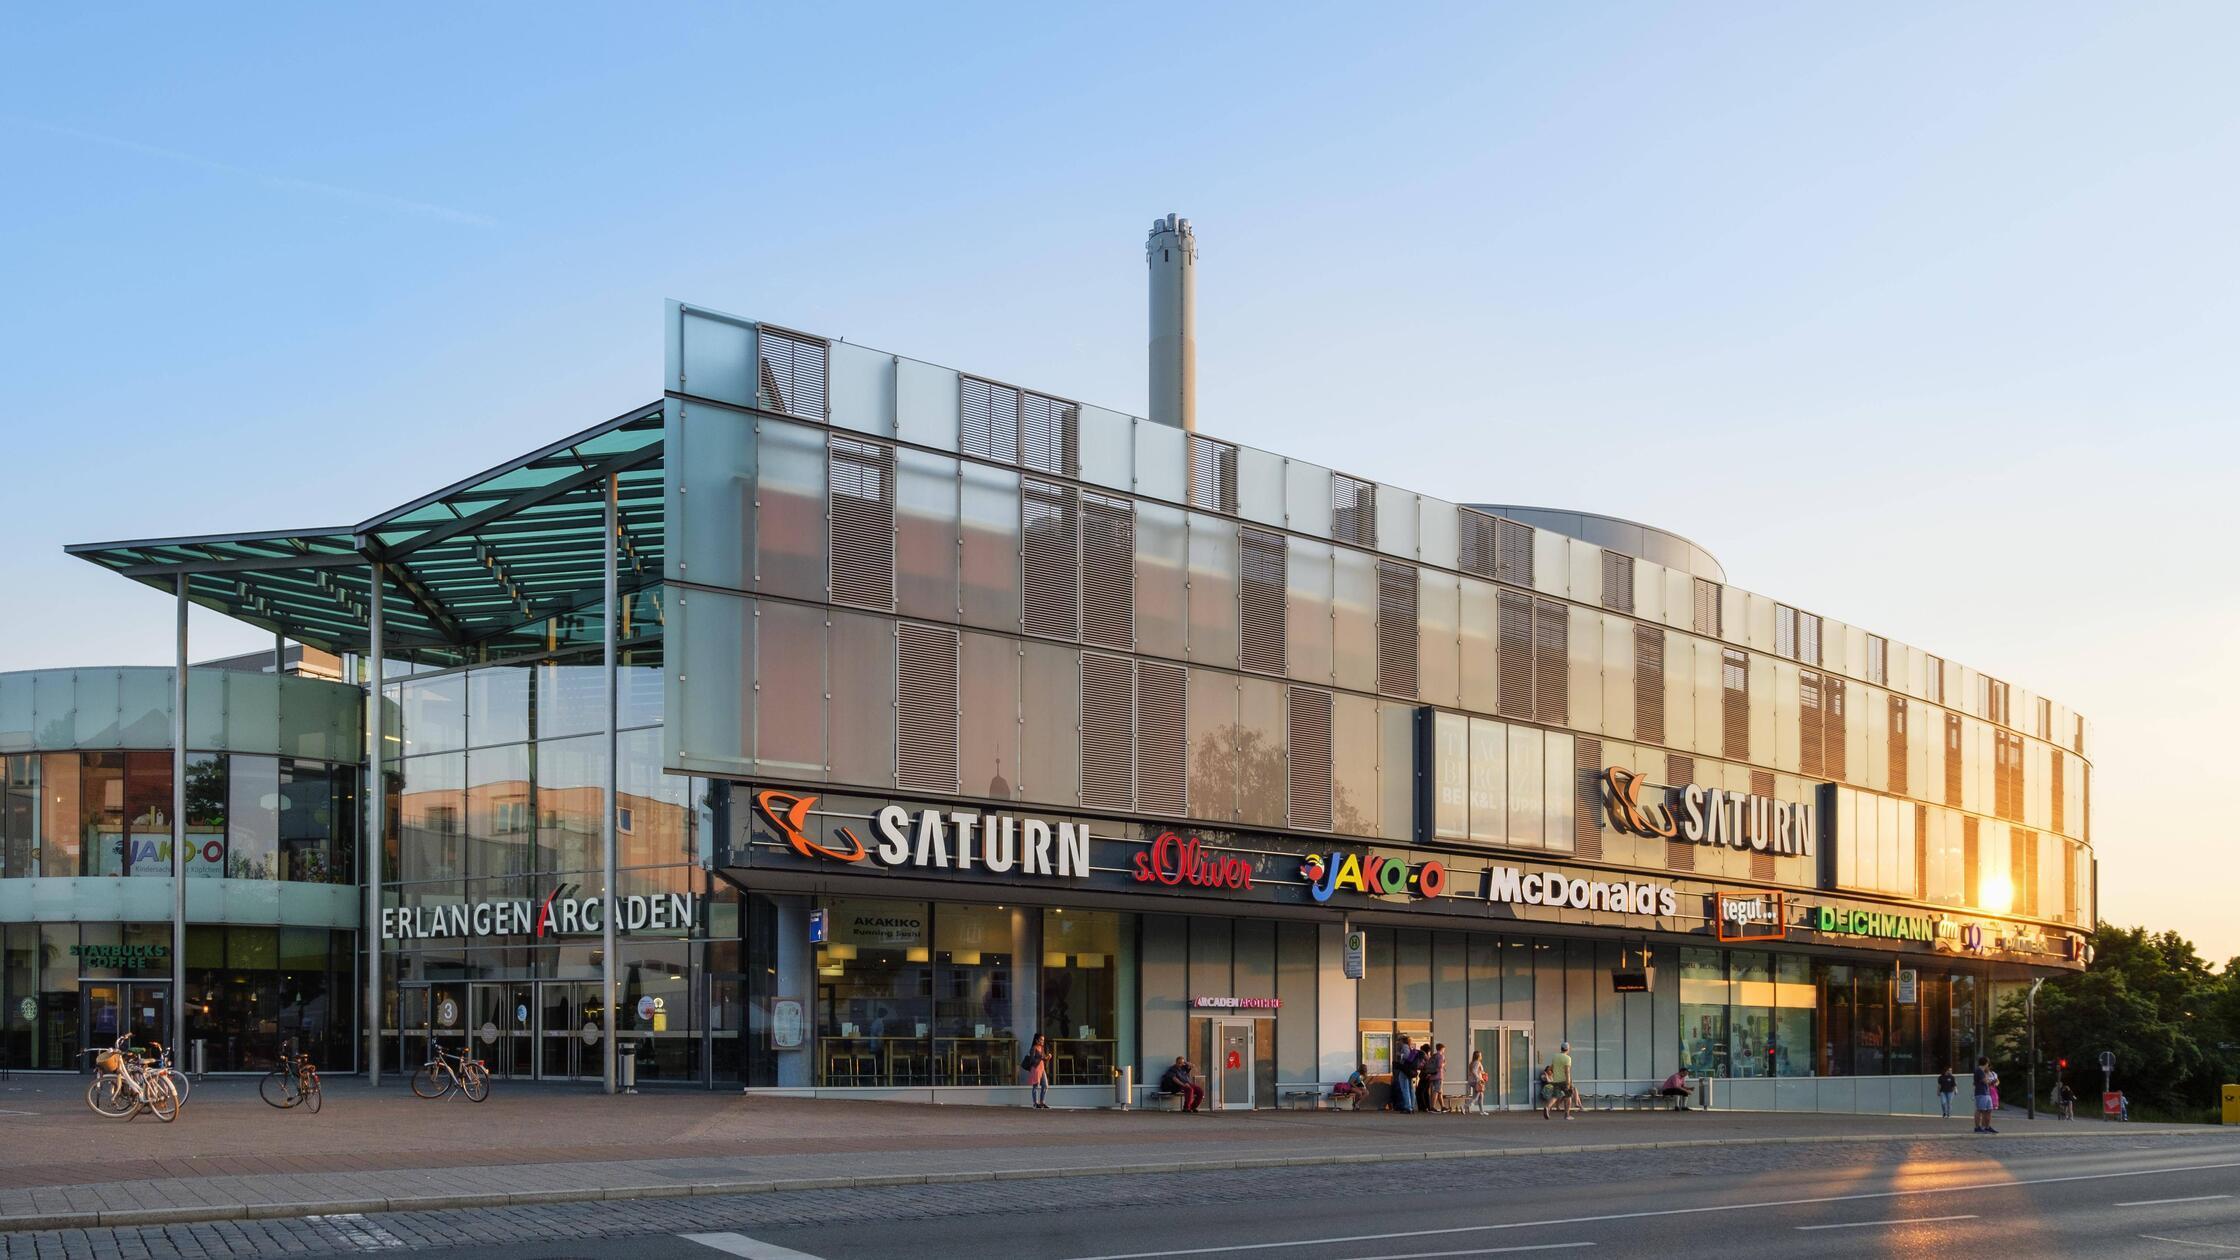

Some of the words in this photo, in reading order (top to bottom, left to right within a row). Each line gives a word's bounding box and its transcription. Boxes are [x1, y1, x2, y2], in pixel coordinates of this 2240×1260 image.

[1685, 783, 1814, 857] SATURN
[879, 805, 1090, 878] SATURN
[1135, 831, 1254, 890] s.Oliver
[1312, 852, 1446, 902] JAKO-O
[1490, 866, 1677, 916] McDonald's
[382, 900, 531, 939] ERLANGEN
[853, 929, 894, 938] Running
[854, 917, 920, 928] AKAKIKO
[1820, 906, 1933, 942] DEICHMANN
[69, 944, 165, 957] STARBUCKS
[86, 957, 146, 968] COFFEE
[444, 1002, 453, 1019] 3
[1195, 994, 1239, 1008] ARCADEN
